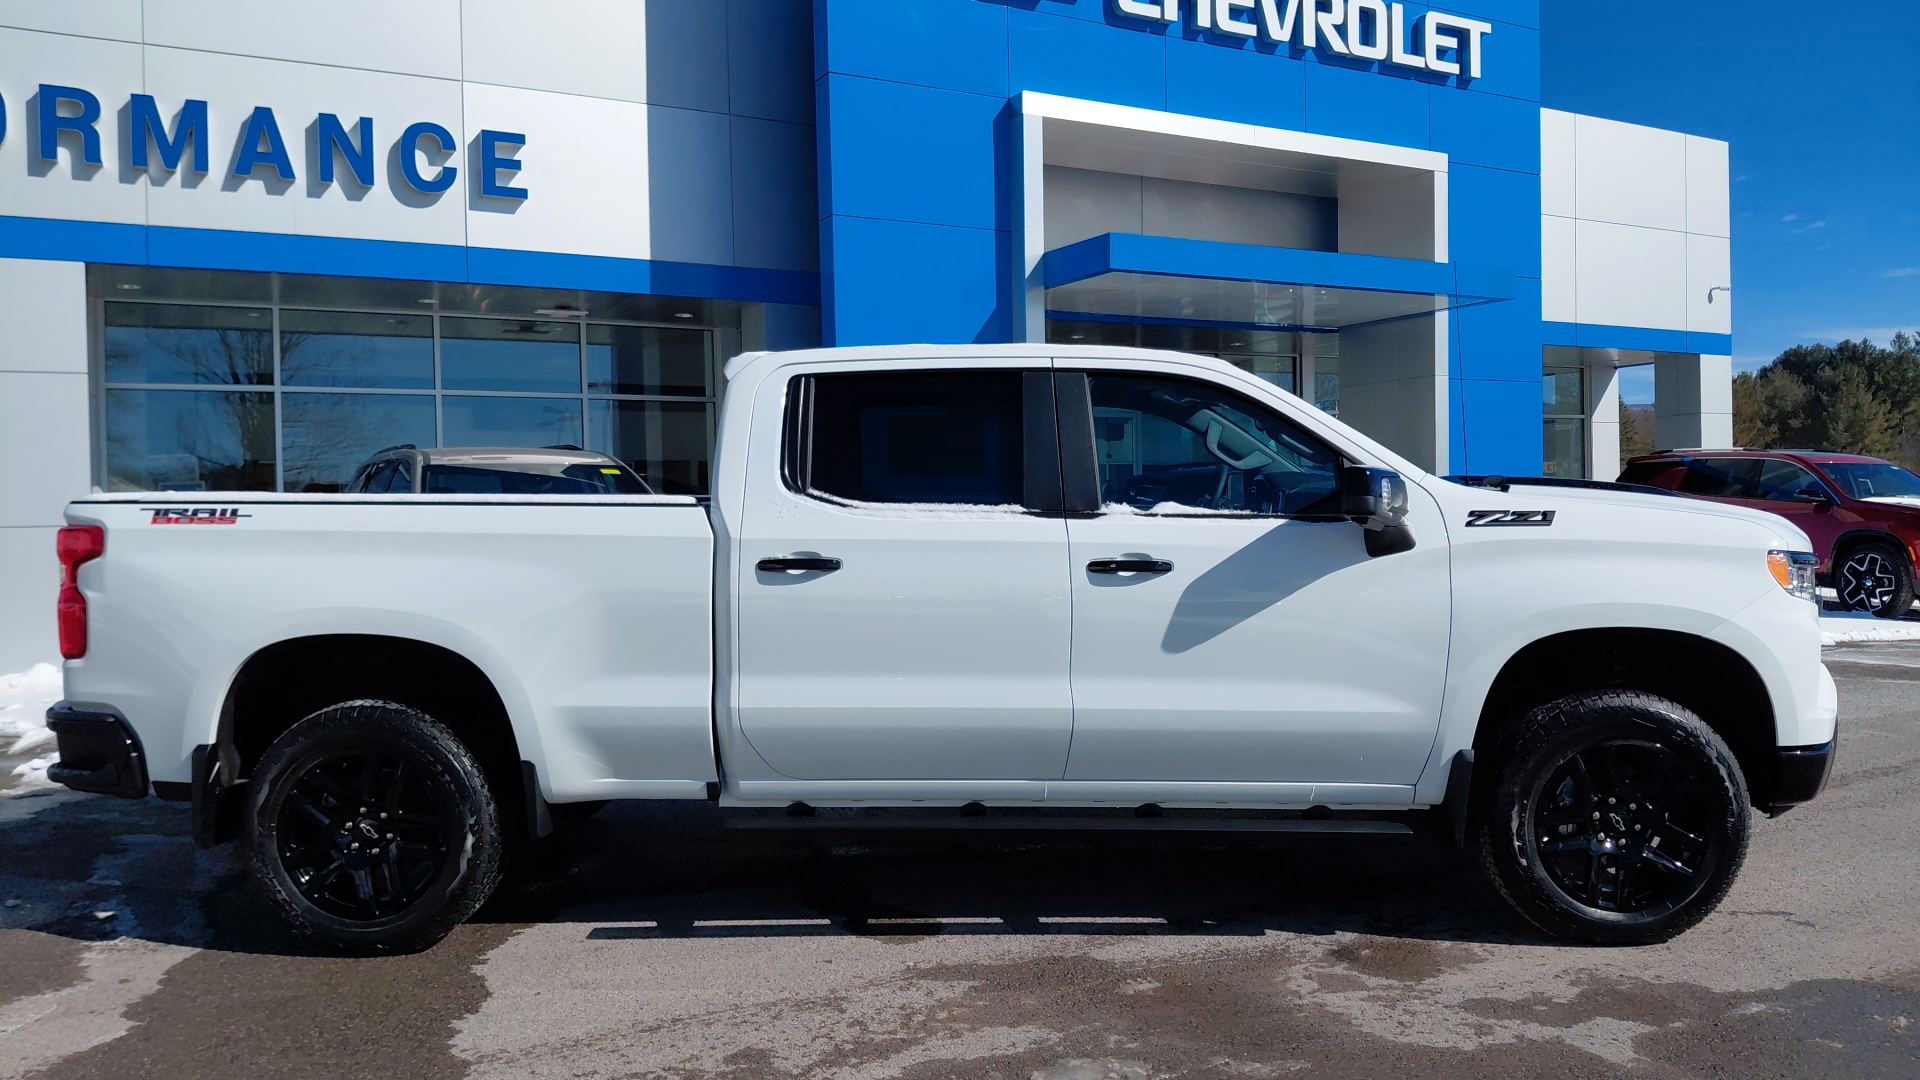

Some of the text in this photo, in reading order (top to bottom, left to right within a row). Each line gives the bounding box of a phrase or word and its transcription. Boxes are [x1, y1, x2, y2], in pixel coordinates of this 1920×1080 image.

[0, 83, 528, 200] RMANCE
[140, 508, 252, 518] TRAIL
[1464, 510, 1557, 528] Z71
[151, 517, 237, 525] BOSS
